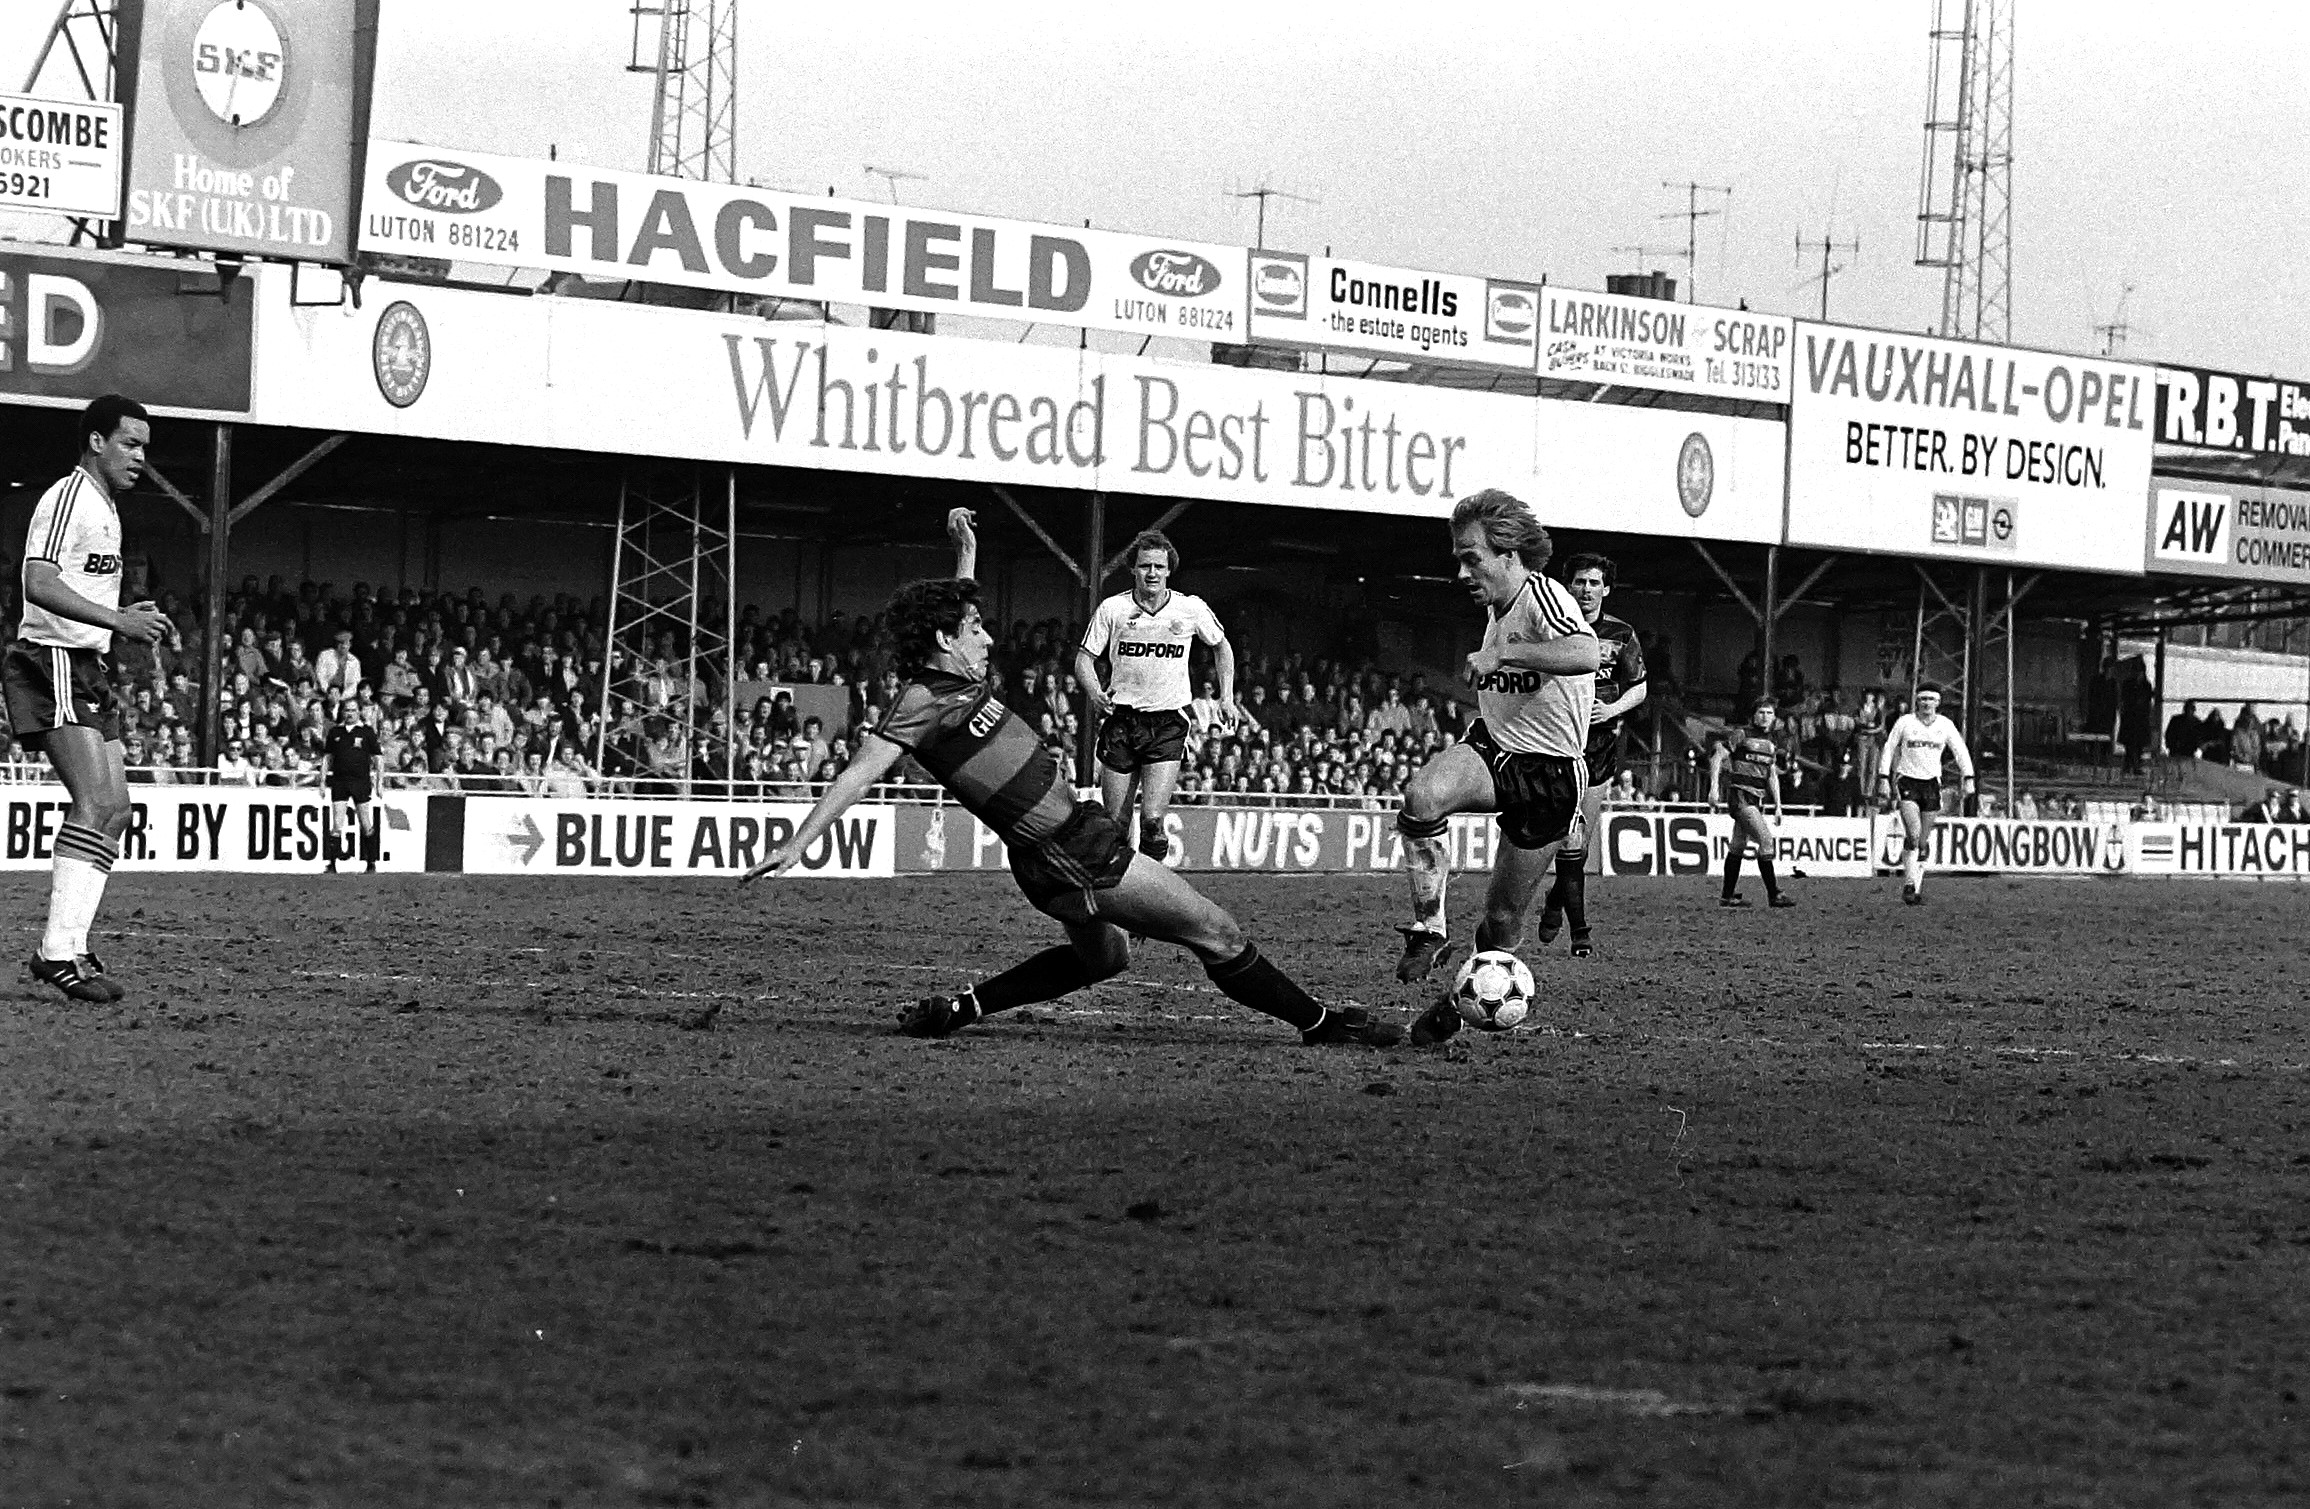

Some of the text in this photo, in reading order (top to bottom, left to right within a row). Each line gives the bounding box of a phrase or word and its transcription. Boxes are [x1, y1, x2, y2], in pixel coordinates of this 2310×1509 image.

[174, 153, 295, 200] Home of
[404, 162, 481, 210] Ford
[369, 214, 520, 251] LUTON 881224
[544, 174, 1092, 314] HACFIELD
[1143, 252, 1204, 293] Ford
[1331, 267, 1458, 317] Connells
[1115, 298, 1233, 331] LUTON 881224
[1331, 309, 1468, 351] the estate agents
[1550, 298, 1786, 359] LARKINSON SCRAP
[1806, 334, 2144, 430] VAUXHALL-OPEL
[721, 332, 1467, 499] Whitbread Best Bitter
[2165, 370, 2276, 452] R.B.T.
[1846, 421, 2107, 490] BETTER. BY DESIGN.
[2162, 500, 2226, 554] AW
[2238, 500, 2310, 532] REMOVA
[1118, 641, 1184, 658] BEDFORD
[177, 803, 227, 860] BY
[556, 813, 673, 869] BLUE
[1212, 811, 1325, 869] NUTS
[1609, 815, 1709, 876] CIS
[1917, 822, 2099, 868] TRONGBOW
